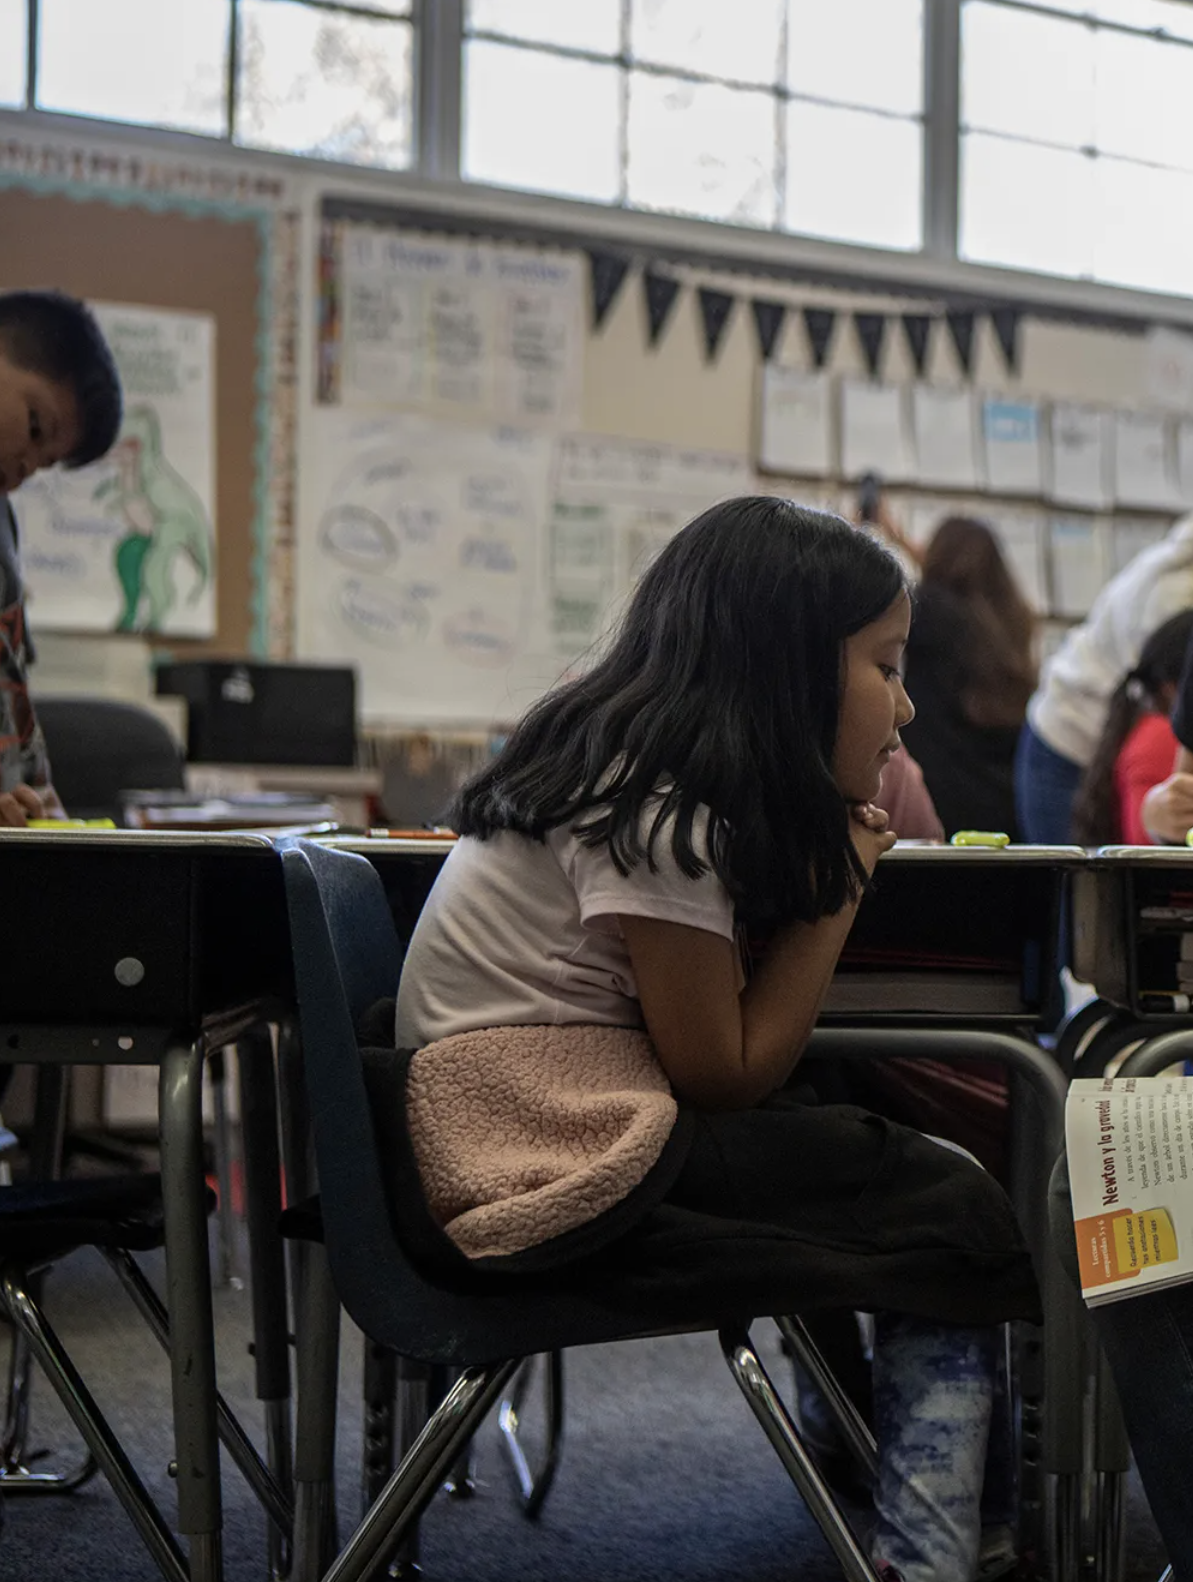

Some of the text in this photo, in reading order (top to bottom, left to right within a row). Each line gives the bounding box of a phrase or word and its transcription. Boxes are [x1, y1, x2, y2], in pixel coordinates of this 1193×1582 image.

[1097, 1134, 1112, 1145] la
[1138, 1141, 1146, 1150] que
[1177, 1144, 1184, 1152] un
[1153, 1160, 1162, 1185] Newton
[1167, 1162, 1173, 1171] un
[1178, 1155, 1187, 1179] durante
[1100, 1156, 1119, 1206] Newton
[1138, 1164, 1150, 1189] leyenda
[1166, 1174, 1175, 1182] de
[1100, 1237, 1111, 1277] compartidas
